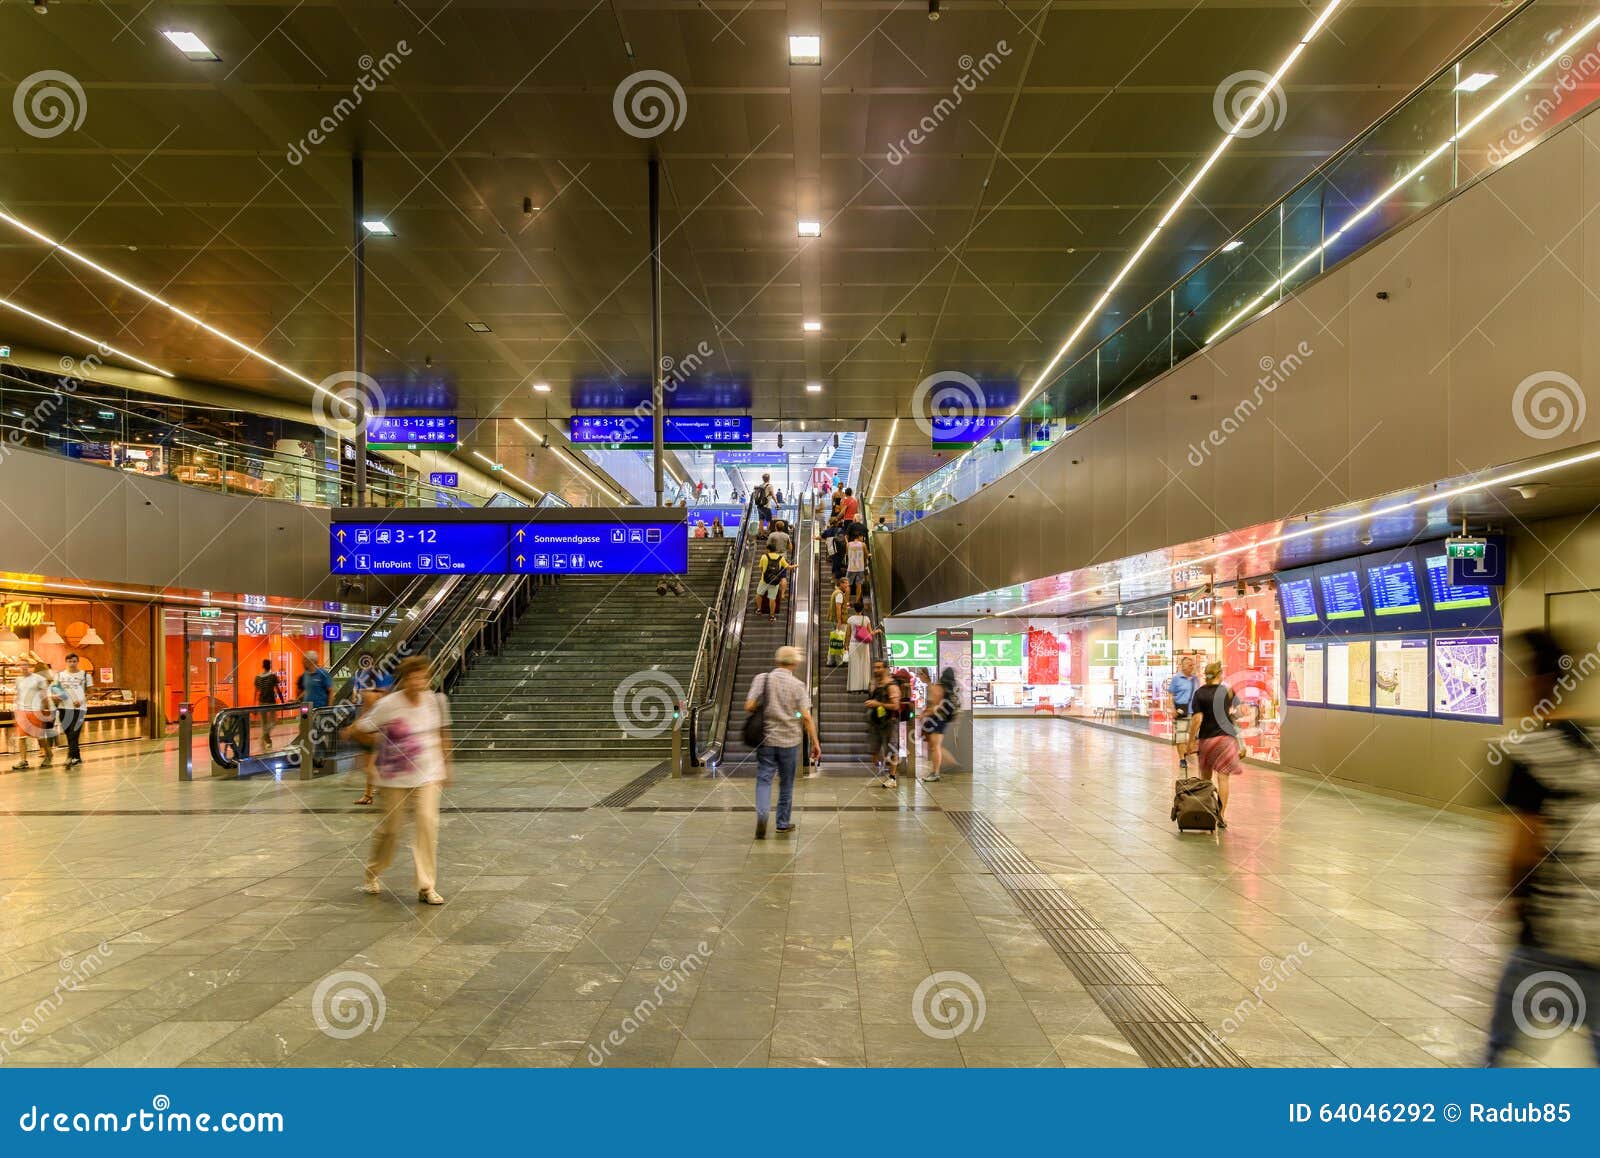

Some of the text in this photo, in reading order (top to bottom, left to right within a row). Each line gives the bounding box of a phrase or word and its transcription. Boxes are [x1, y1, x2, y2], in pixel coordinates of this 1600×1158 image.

[534, 535, 601, 545] Sonnwendgasse
[373, 560, 412, 569] InfoPoint
[588, 560, 604, 568] WC
[4, 601, 45, 631] Felber
[1174, 598, 1214, 619] DEPOT
[885, 639, 1012, 659] DEOT
